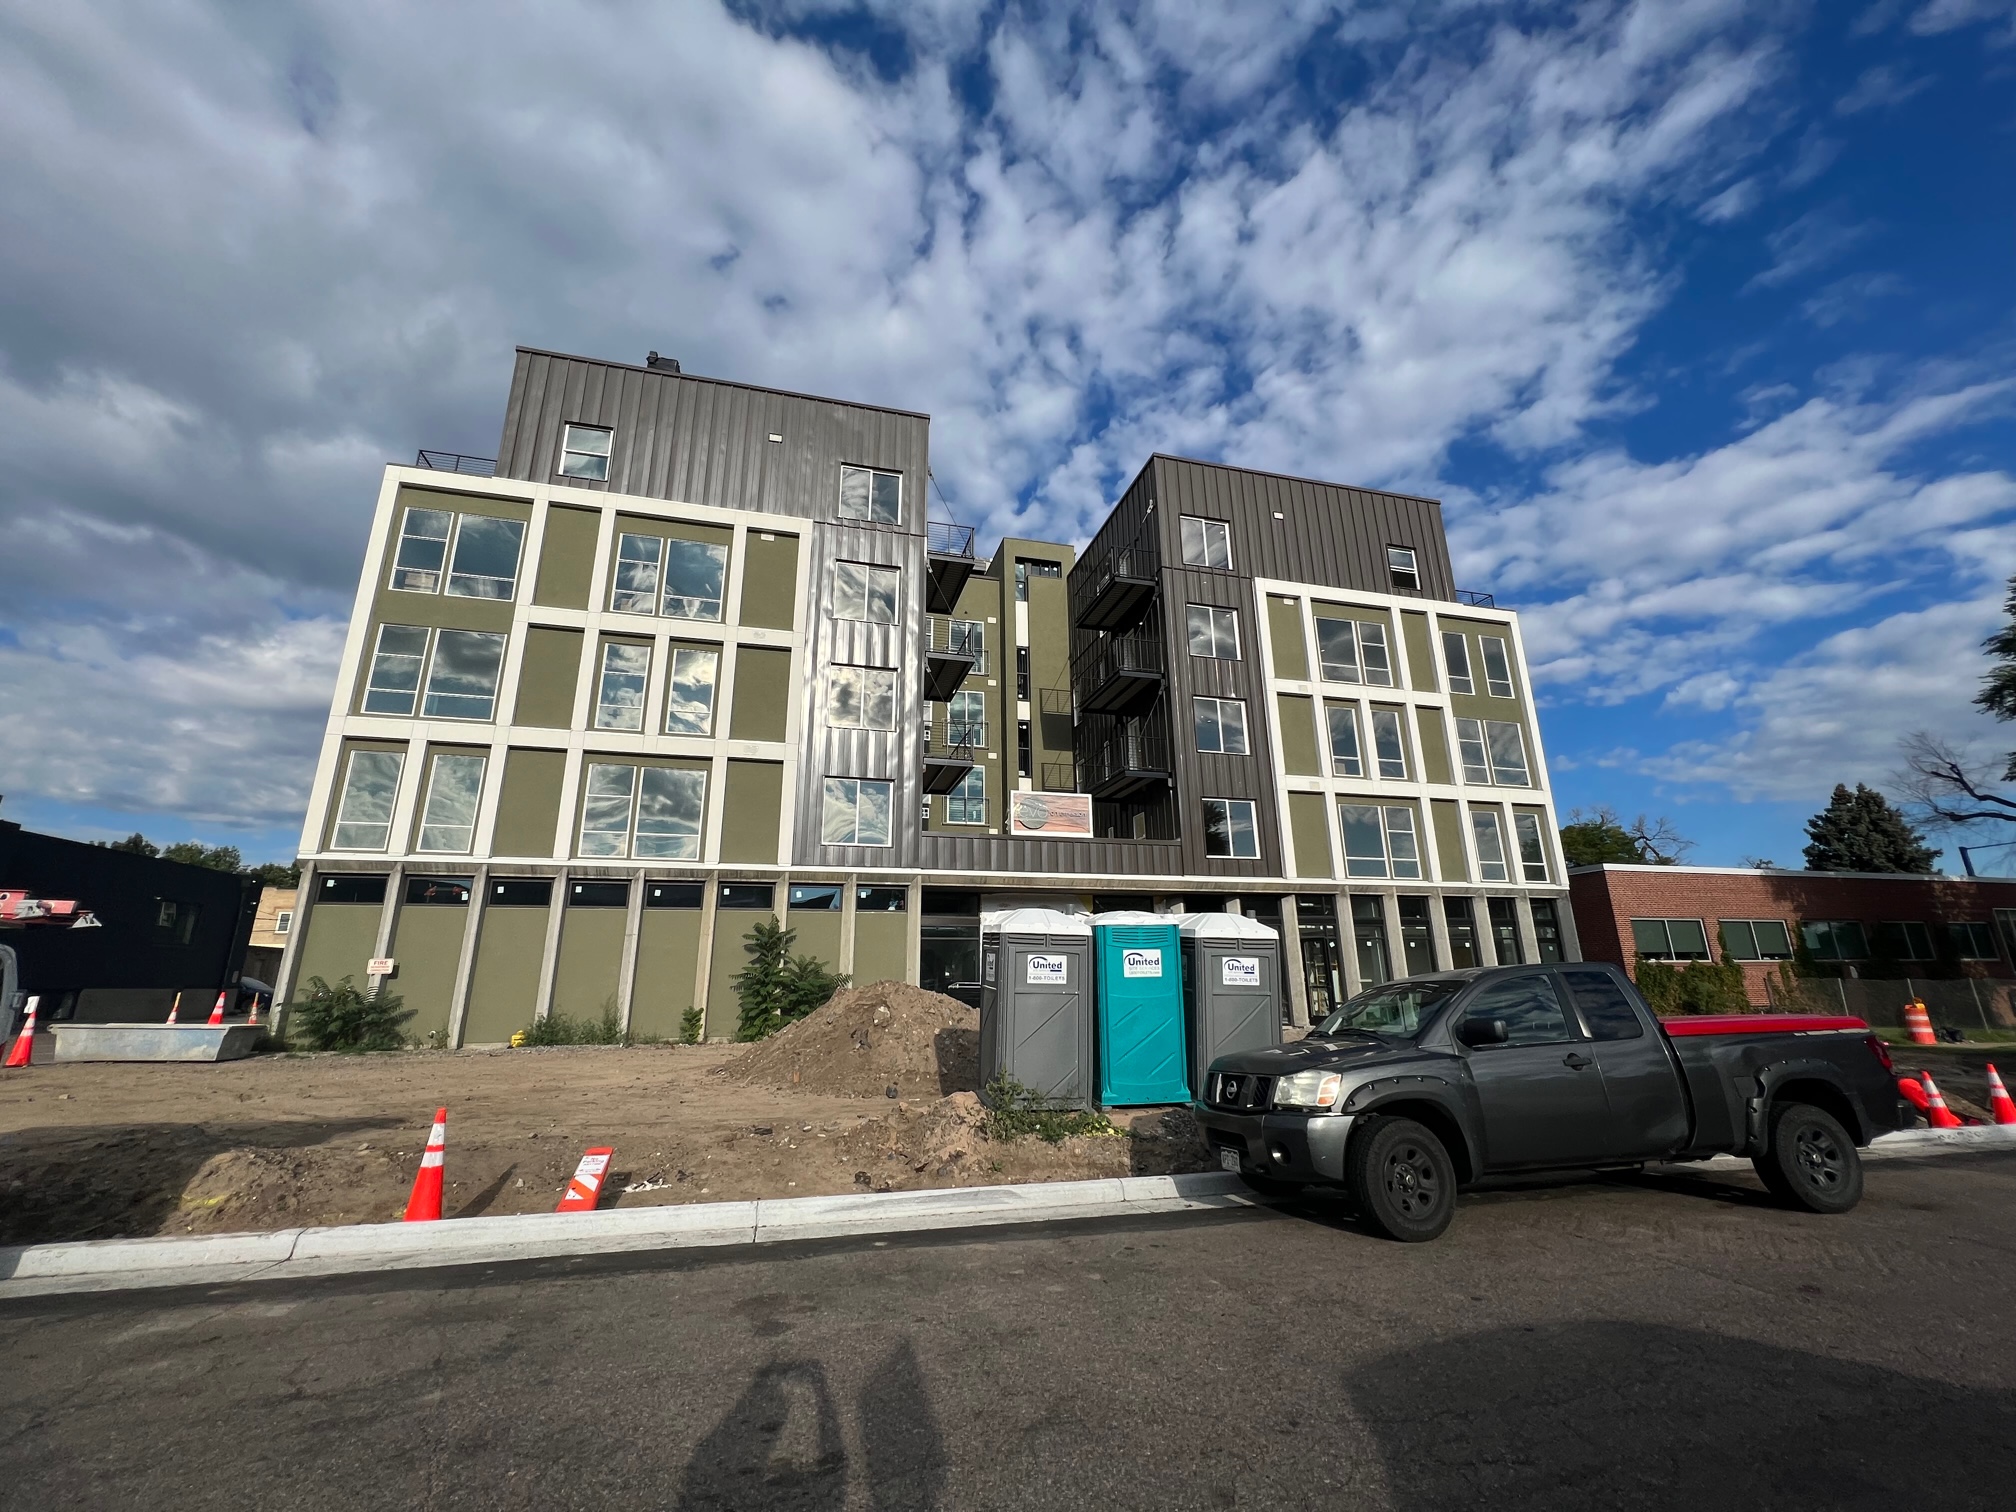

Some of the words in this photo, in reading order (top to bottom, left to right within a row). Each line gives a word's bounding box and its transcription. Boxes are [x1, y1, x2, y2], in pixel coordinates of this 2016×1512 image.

[1032, 960, 1063, 969] United
[1128, 957, 1160, 966] United
[1227, 963, 1255, 972] United
